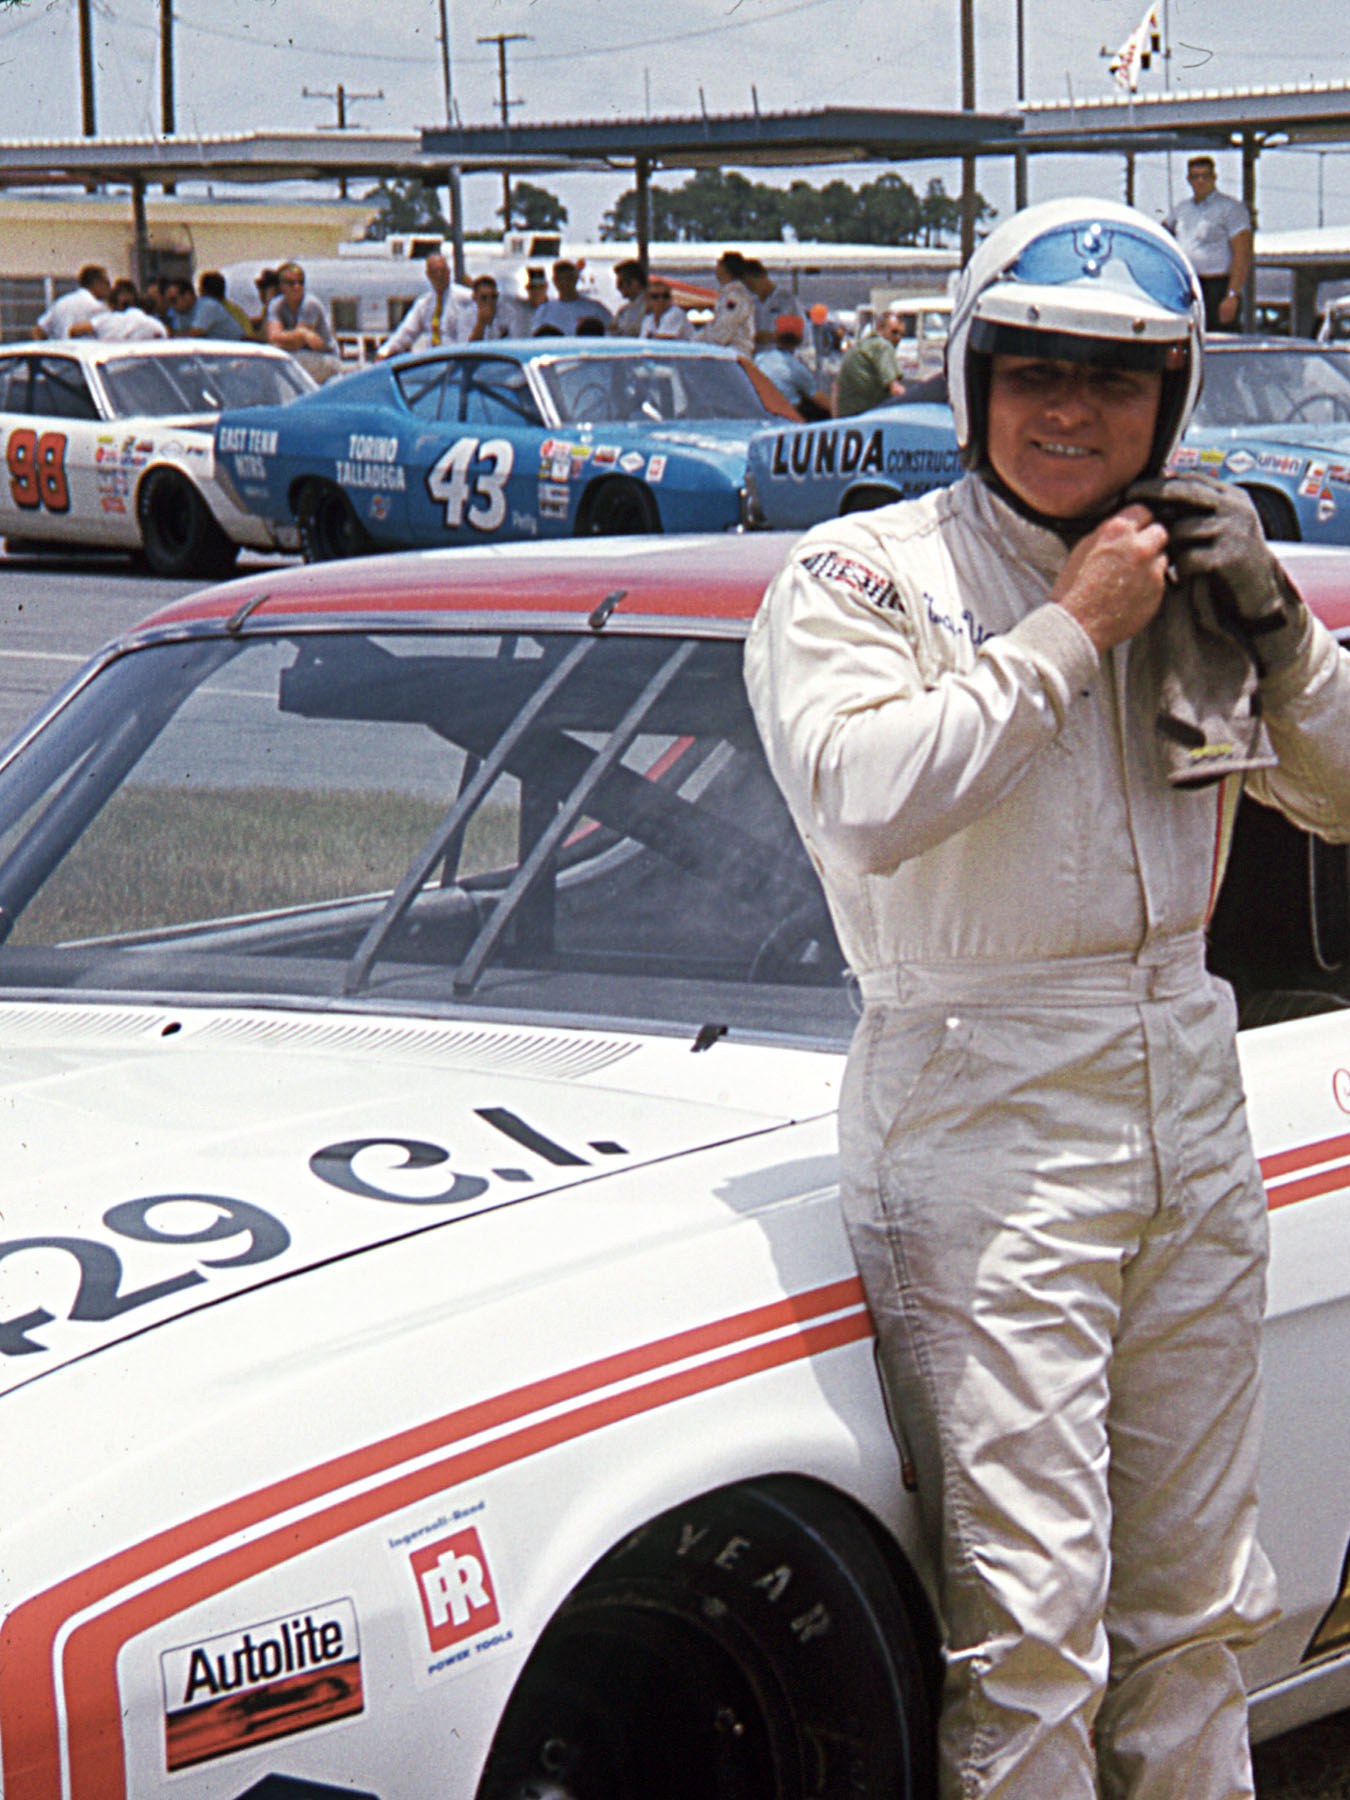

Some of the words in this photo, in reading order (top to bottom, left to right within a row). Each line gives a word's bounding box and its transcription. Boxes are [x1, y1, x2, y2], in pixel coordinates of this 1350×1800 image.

[219, 427, 247, 452] EAST
[349, 433, 399, 463] TORINO
[772, 429, 884, 478] LUNDA
[887, 447, 966, 473] CONSTRUCT
[7, 427, 71, 515] 98
[335, 460, 407, 491] TALLADEGA
[426, 437, 515, 532] 43
[183, 1615, 344, 1704] Autolite
[427, 1648, 470, 1675] POWER
[475, 1630, 514, 1653] TOOLS
